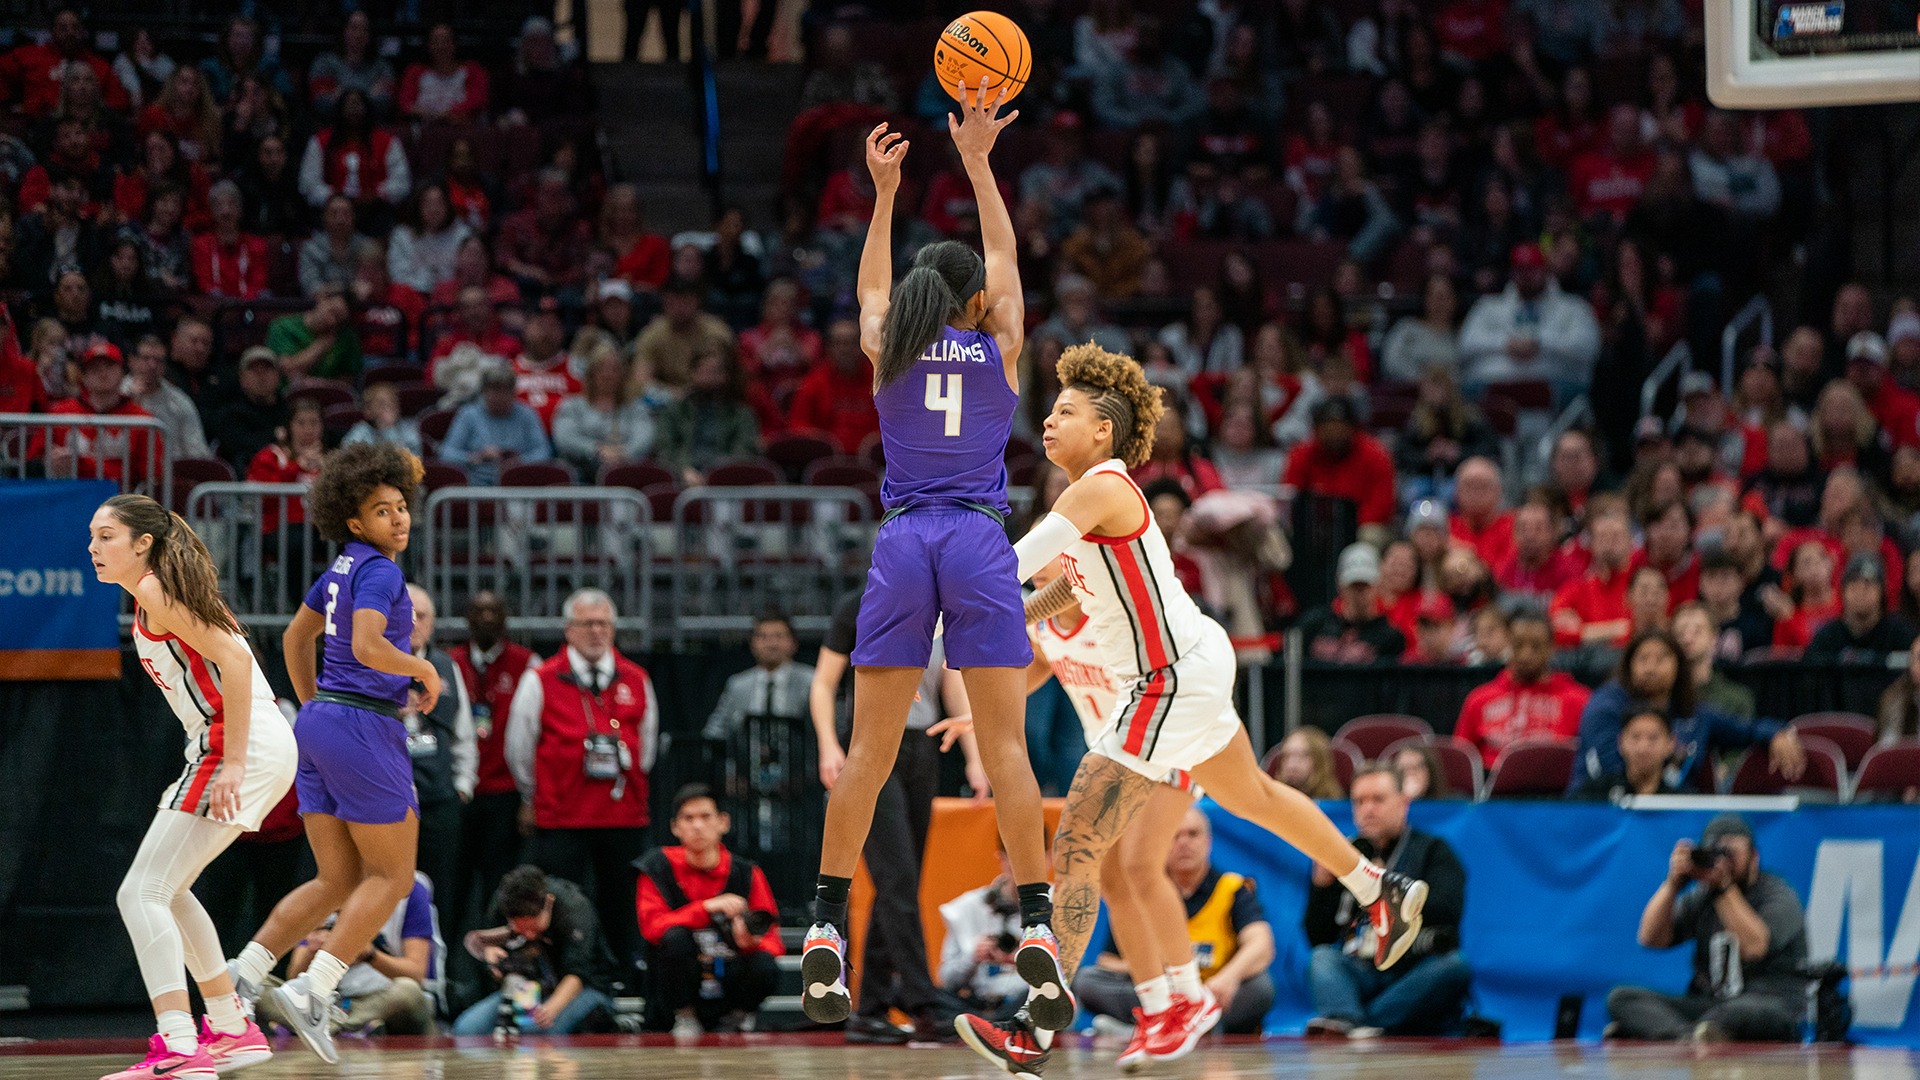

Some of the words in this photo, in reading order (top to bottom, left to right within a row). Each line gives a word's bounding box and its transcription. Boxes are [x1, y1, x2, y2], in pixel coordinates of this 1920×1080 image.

[944, 20, 989, 58] Wilson
[924, 373, 963, 437] 4
[325, 581, 338, 636] 2
[1084, 693, 1103, 721] 1
